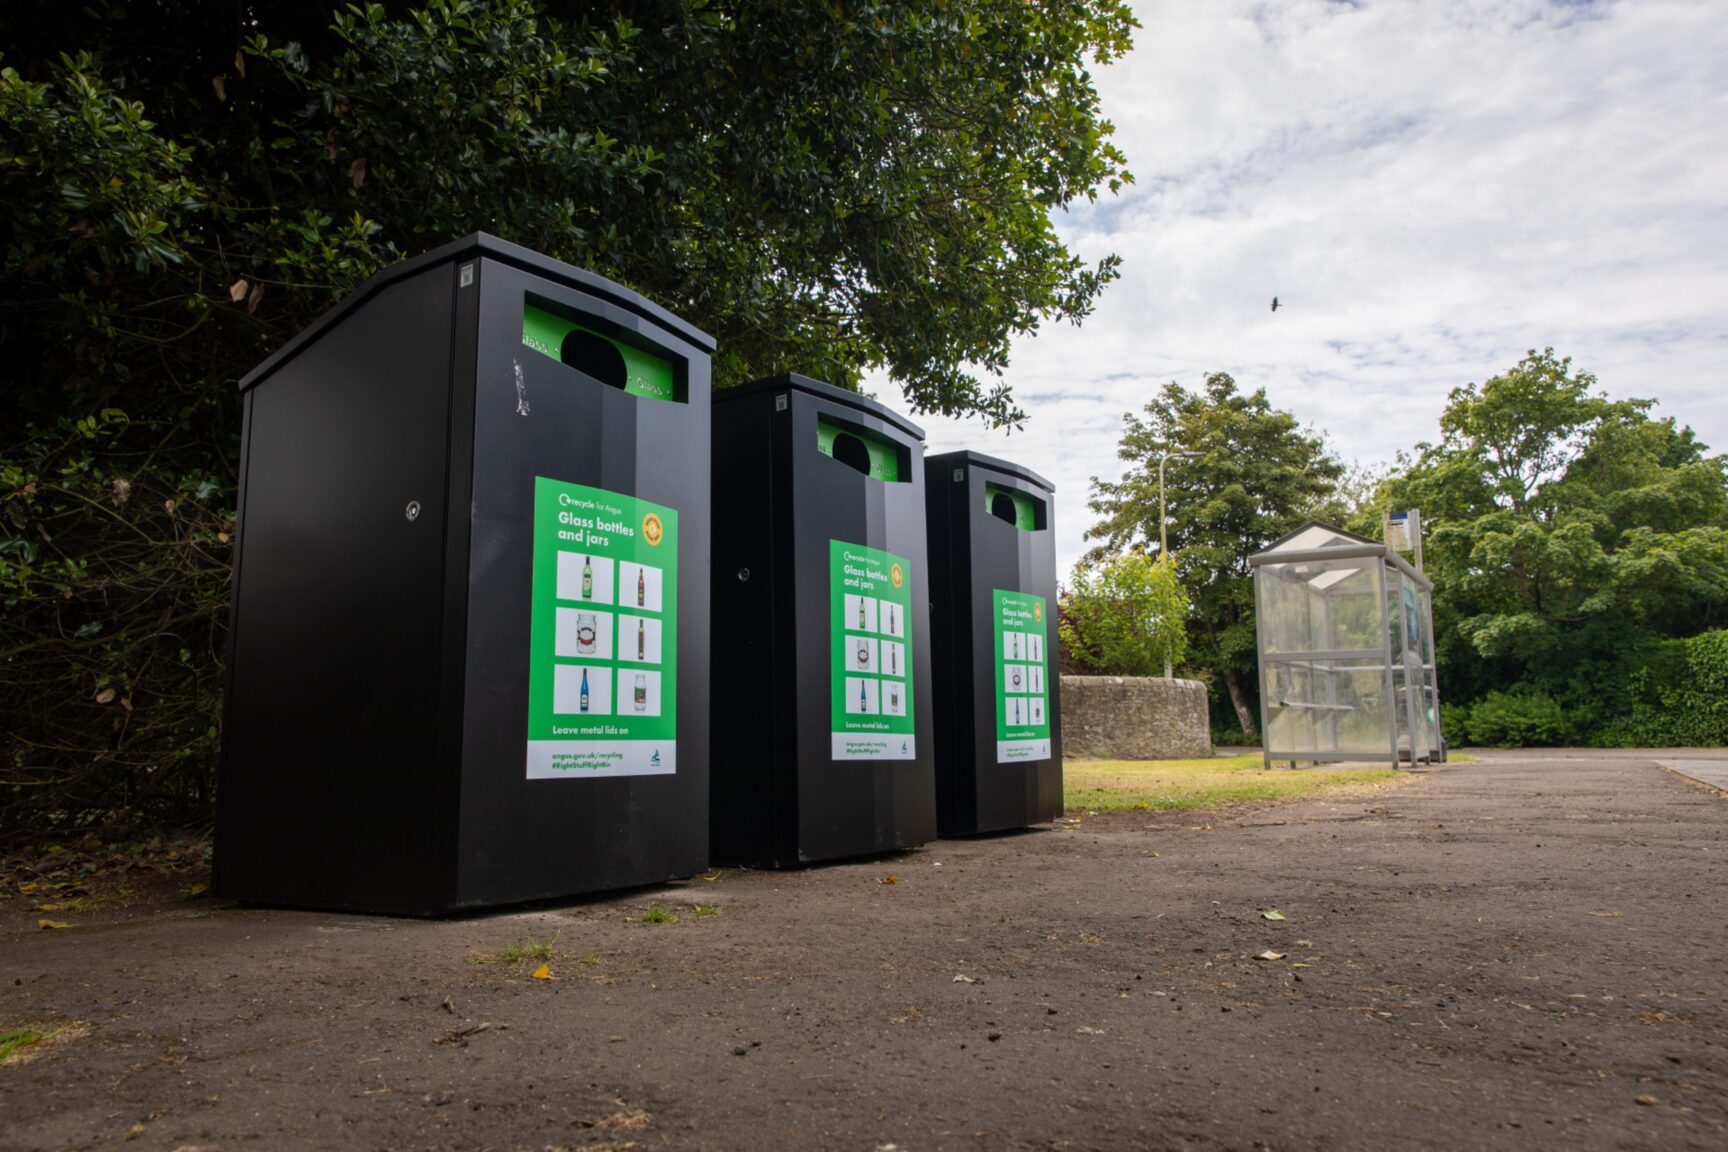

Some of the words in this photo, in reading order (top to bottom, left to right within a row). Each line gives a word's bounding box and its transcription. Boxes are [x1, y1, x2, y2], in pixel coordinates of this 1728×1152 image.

[571, 499, 595, 509] recycle
[558, 511, 594, 529] Glass
[596, 516, 635, 537] bottles
[558, 529, 583, 542] and
[586, 530, 609, 547] jars
[844, 564, 864, 576] Glass
[866, 567, 888, 582] bottles
[844, 578, 859, 587] and
[860, 578, 874, 591] jars
[552, 725, 579, 735] Leave
[580, 725, 604, 735] metal
[605, 725, 618, 735] lids
[552, 752, 624, 760] angus.gov.uk/recycling
